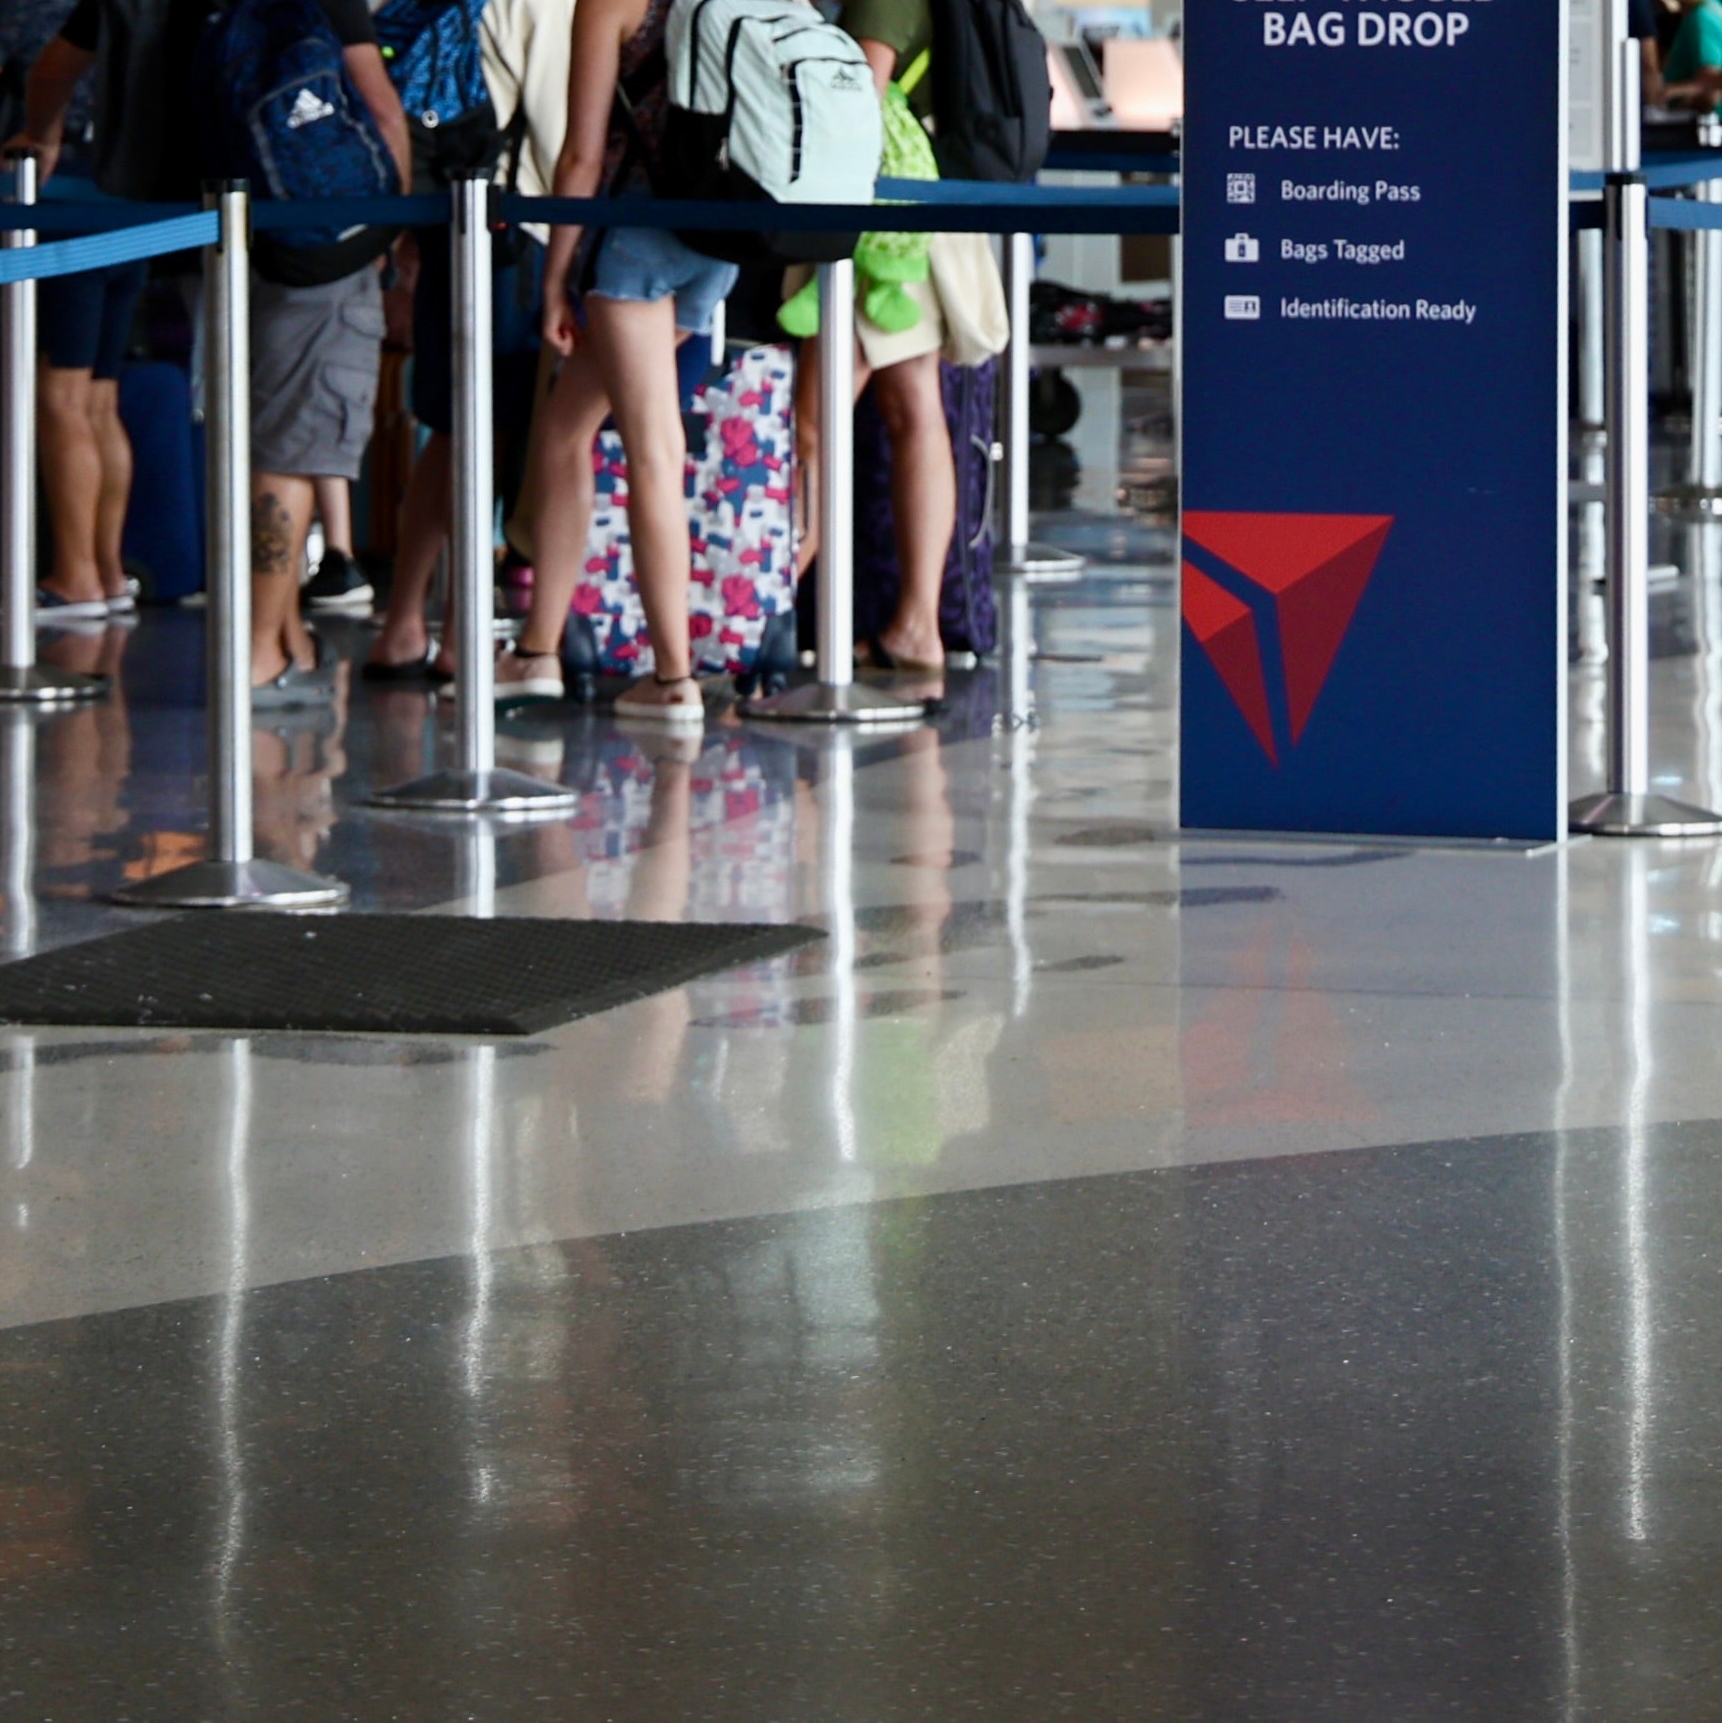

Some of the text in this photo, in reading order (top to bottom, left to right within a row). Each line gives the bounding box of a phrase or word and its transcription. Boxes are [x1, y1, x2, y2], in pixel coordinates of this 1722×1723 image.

[1264, 12, 1469, 46] BAG DROP
[1229, 126, 1399, 149] PLEASE HAVE:
[1282, 180, 1421, 205] Boarding Pass
[1281, 239, 1404, 264] Bags Tagged
[1281, 298, 1476, 324] Identification Ready
